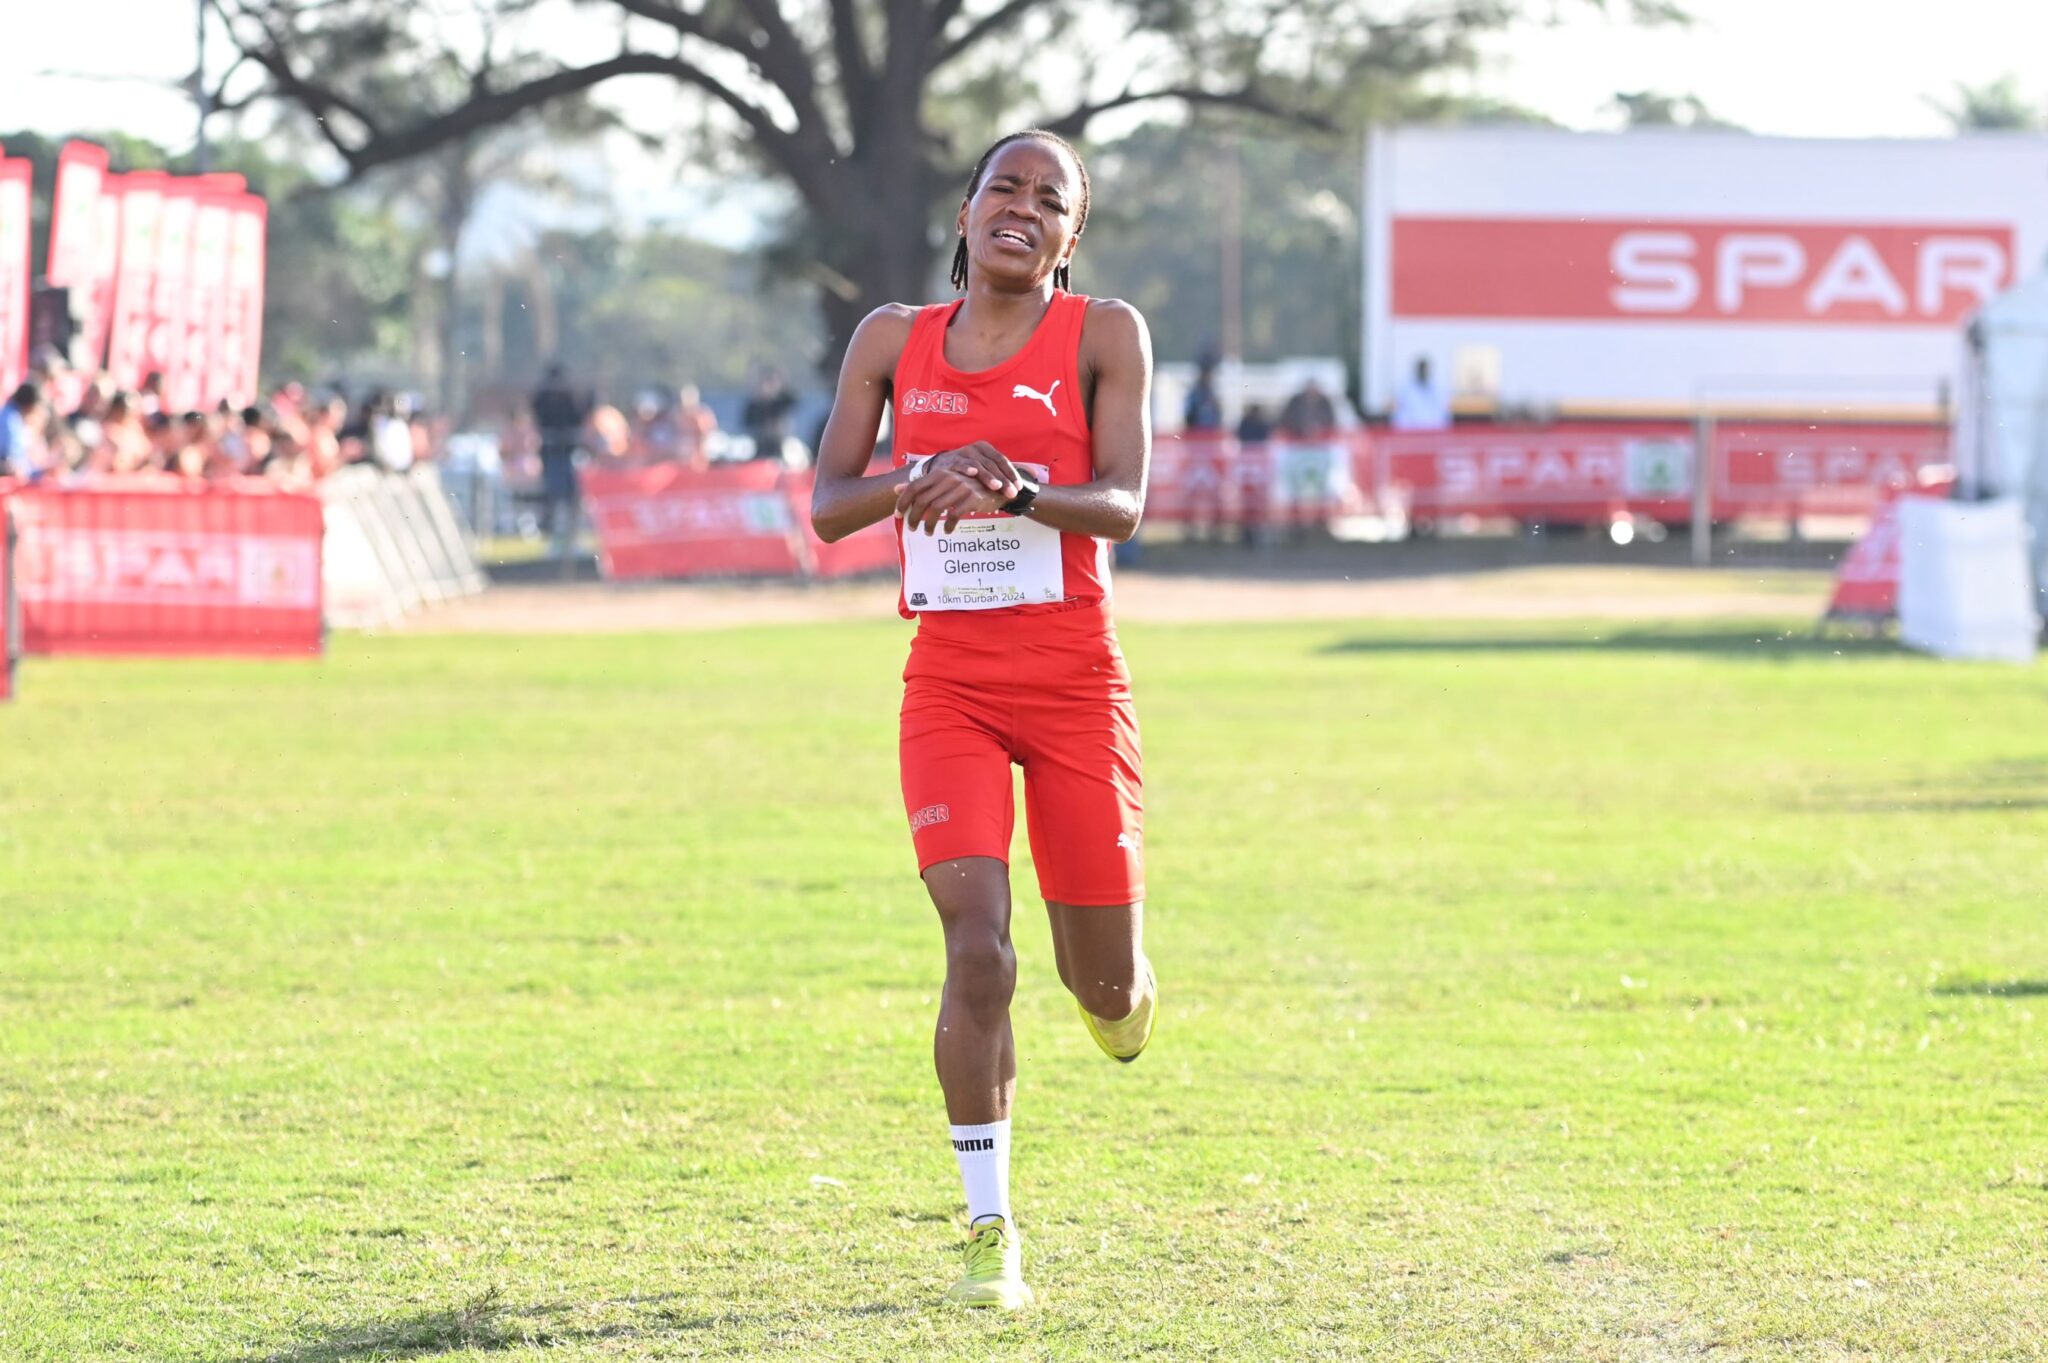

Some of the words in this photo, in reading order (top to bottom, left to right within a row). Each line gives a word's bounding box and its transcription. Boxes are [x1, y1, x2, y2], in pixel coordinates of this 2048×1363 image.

[1608, 230, 2008, 315] SPAR
[1438, 447, 1620, 493] SPAR
[938, 537, 1020, 554] Dimakatso
[944, 559, 1015, 574] Glenrose
[977, 578, 982, 587] 1
[938, 594, 961, 604] 10km
[964, 593, 998, 604] Durban
[1001, 592, 1025, 602] 2024
[911, 804, 949, 831] OKER
[952, 1138, 994, 1152] PUMA
